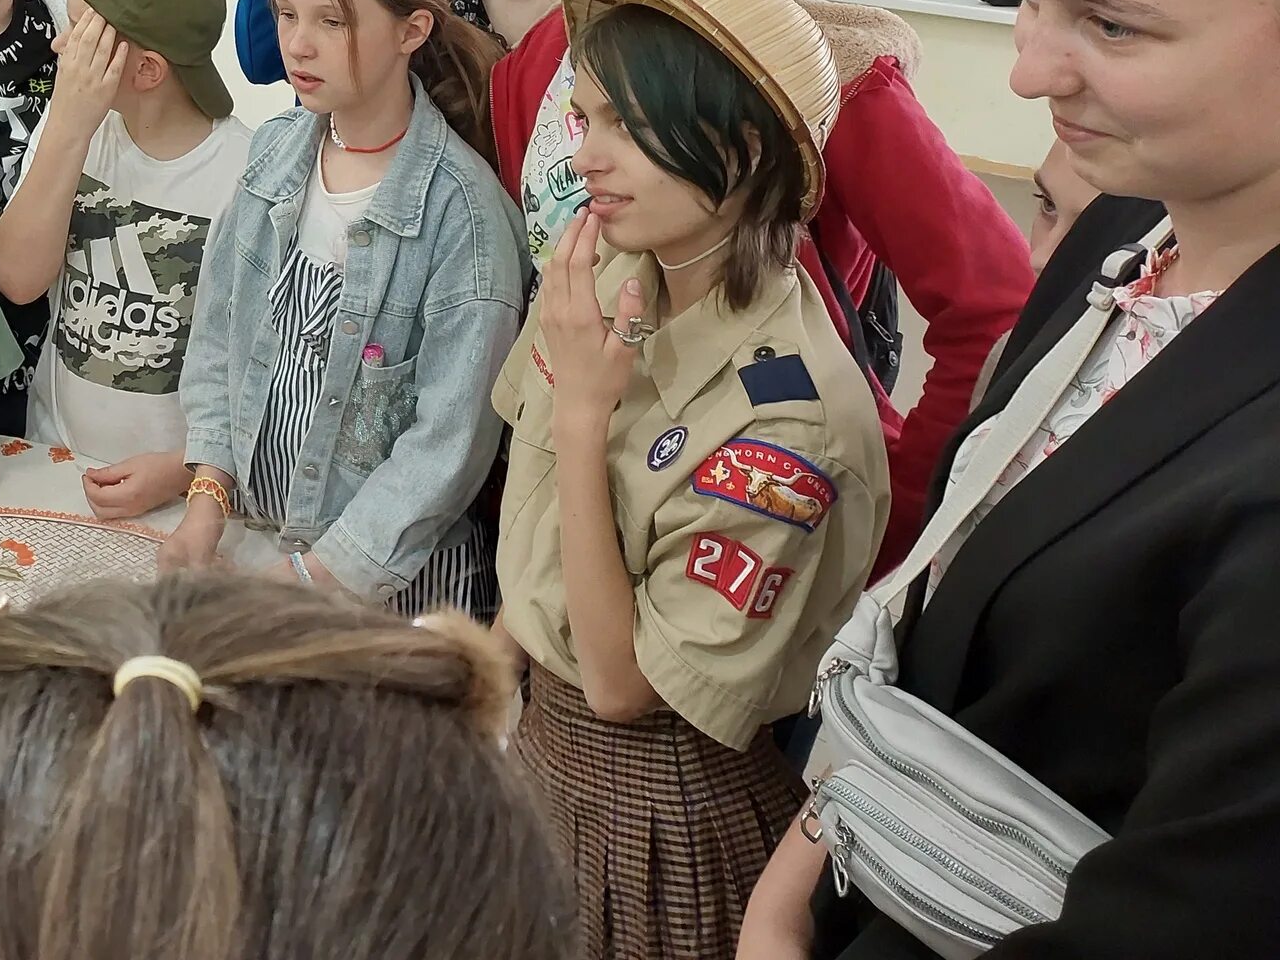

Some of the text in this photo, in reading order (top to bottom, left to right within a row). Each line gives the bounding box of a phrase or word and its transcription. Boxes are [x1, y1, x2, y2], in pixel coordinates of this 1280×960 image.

[63, 273, 182, 334] didas
[707, 449, 778, 464] NGHORN
[693, 538, 784, 612] 276
